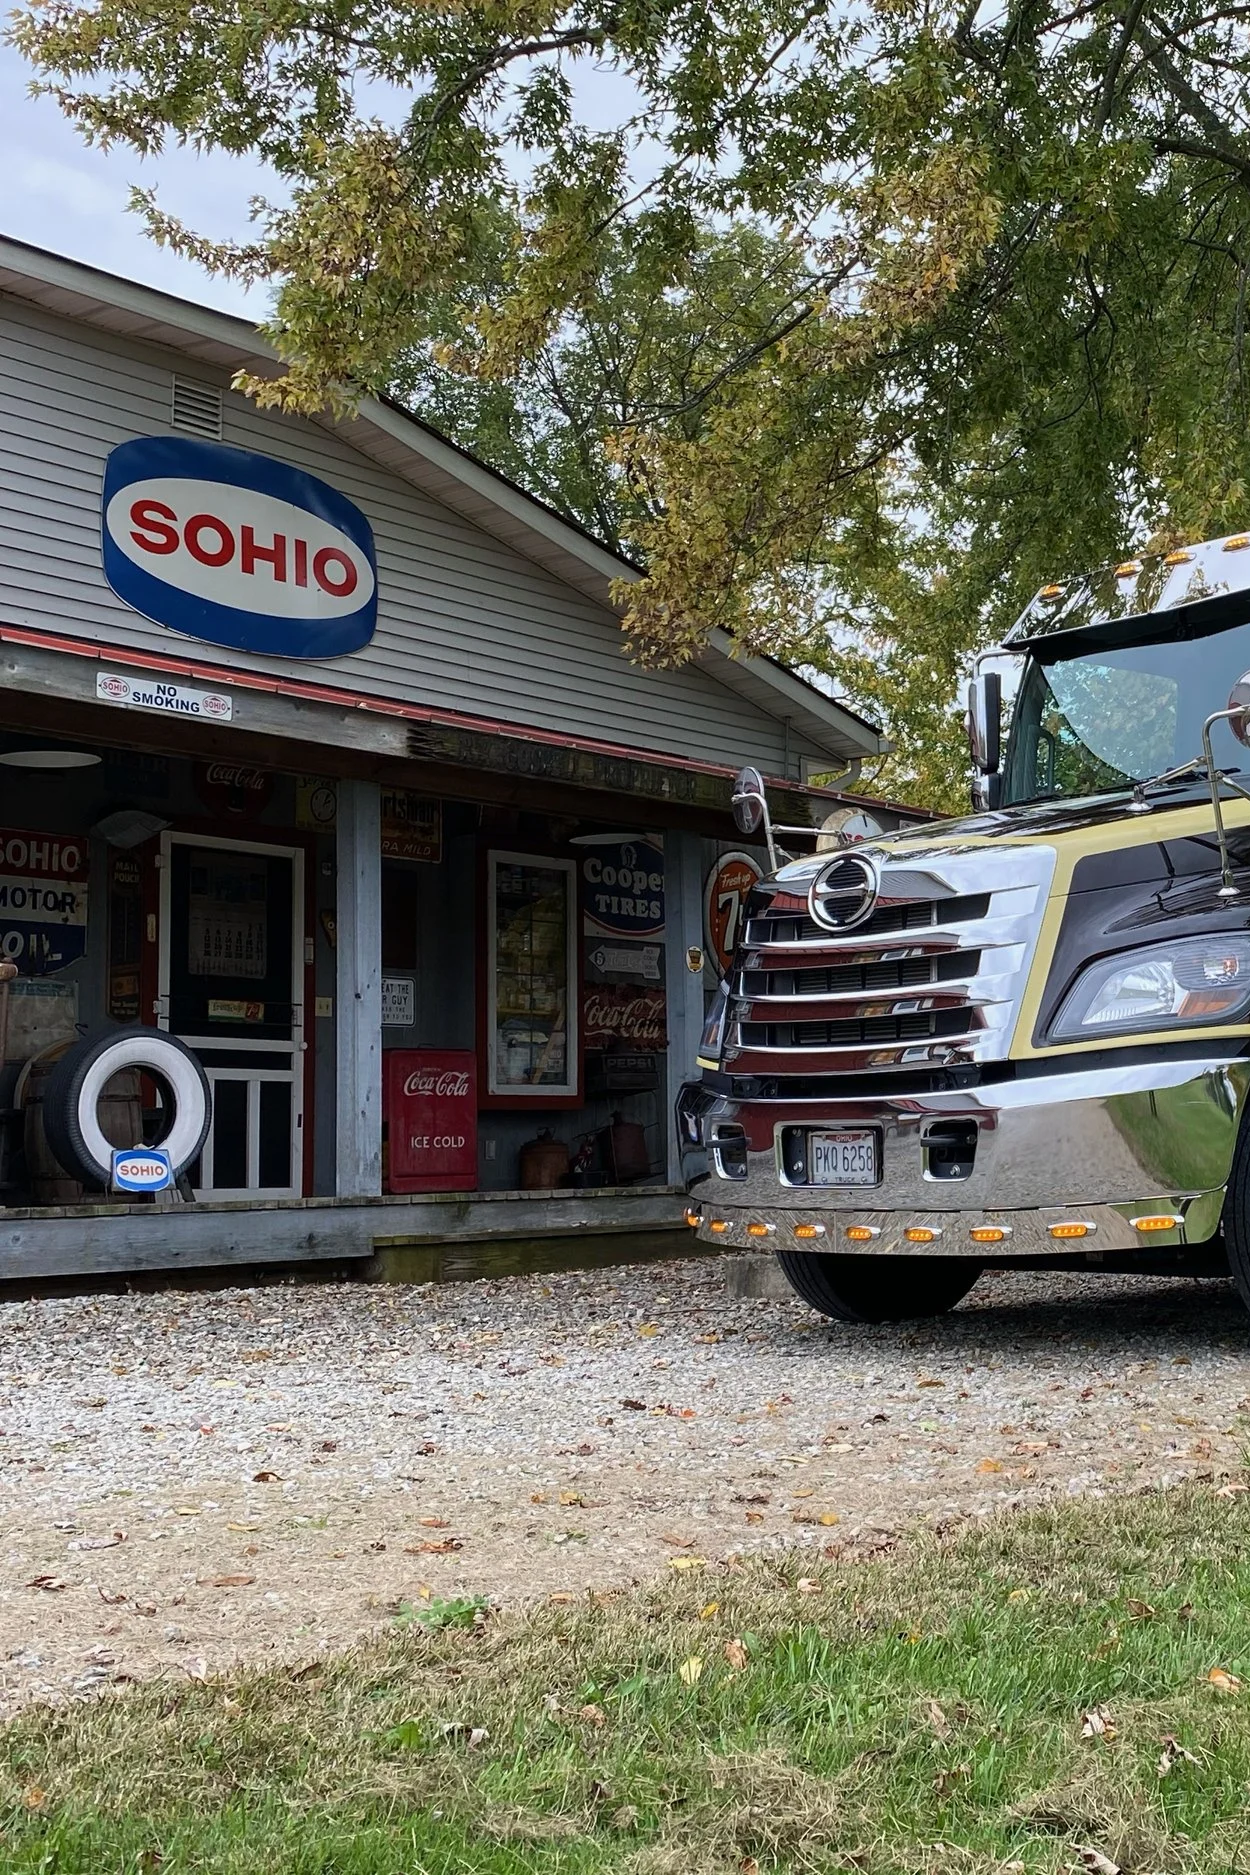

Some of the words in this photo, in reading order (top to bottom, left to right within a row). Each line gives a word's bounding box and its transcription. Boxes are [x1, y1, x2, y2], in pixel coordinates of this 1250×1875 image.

[130, 499, 358, 597] SOHIO
[102, 682, 128, 693] SOHIO
[157, 684, 177, 697] NO
[132, 691, 200, 713] SMOKING
[204, 700, 227, 711] SOHIO
[0, 838, 80, 873] OHIO
[402, 843, 431, 856] MILD
[115, 861, 139, 873] MAIL
[594, 894, 662, 919] TIRES
[397, 984, 409, 994] THE
[391, 995, 408, 1005] GUY
[606, 1057, 652, 1069] PEPSI
[403, 1070, 471, 1097] Coca-Cola
[411, 1136, 430, 1148] ICE
[433, 1136, 465, 1148] COLD
[815, 1146, 838, 1173] PKQ
[842, 1145, 873, 1173] 6258
[120, 1163, 164, 1178] SOHIO
